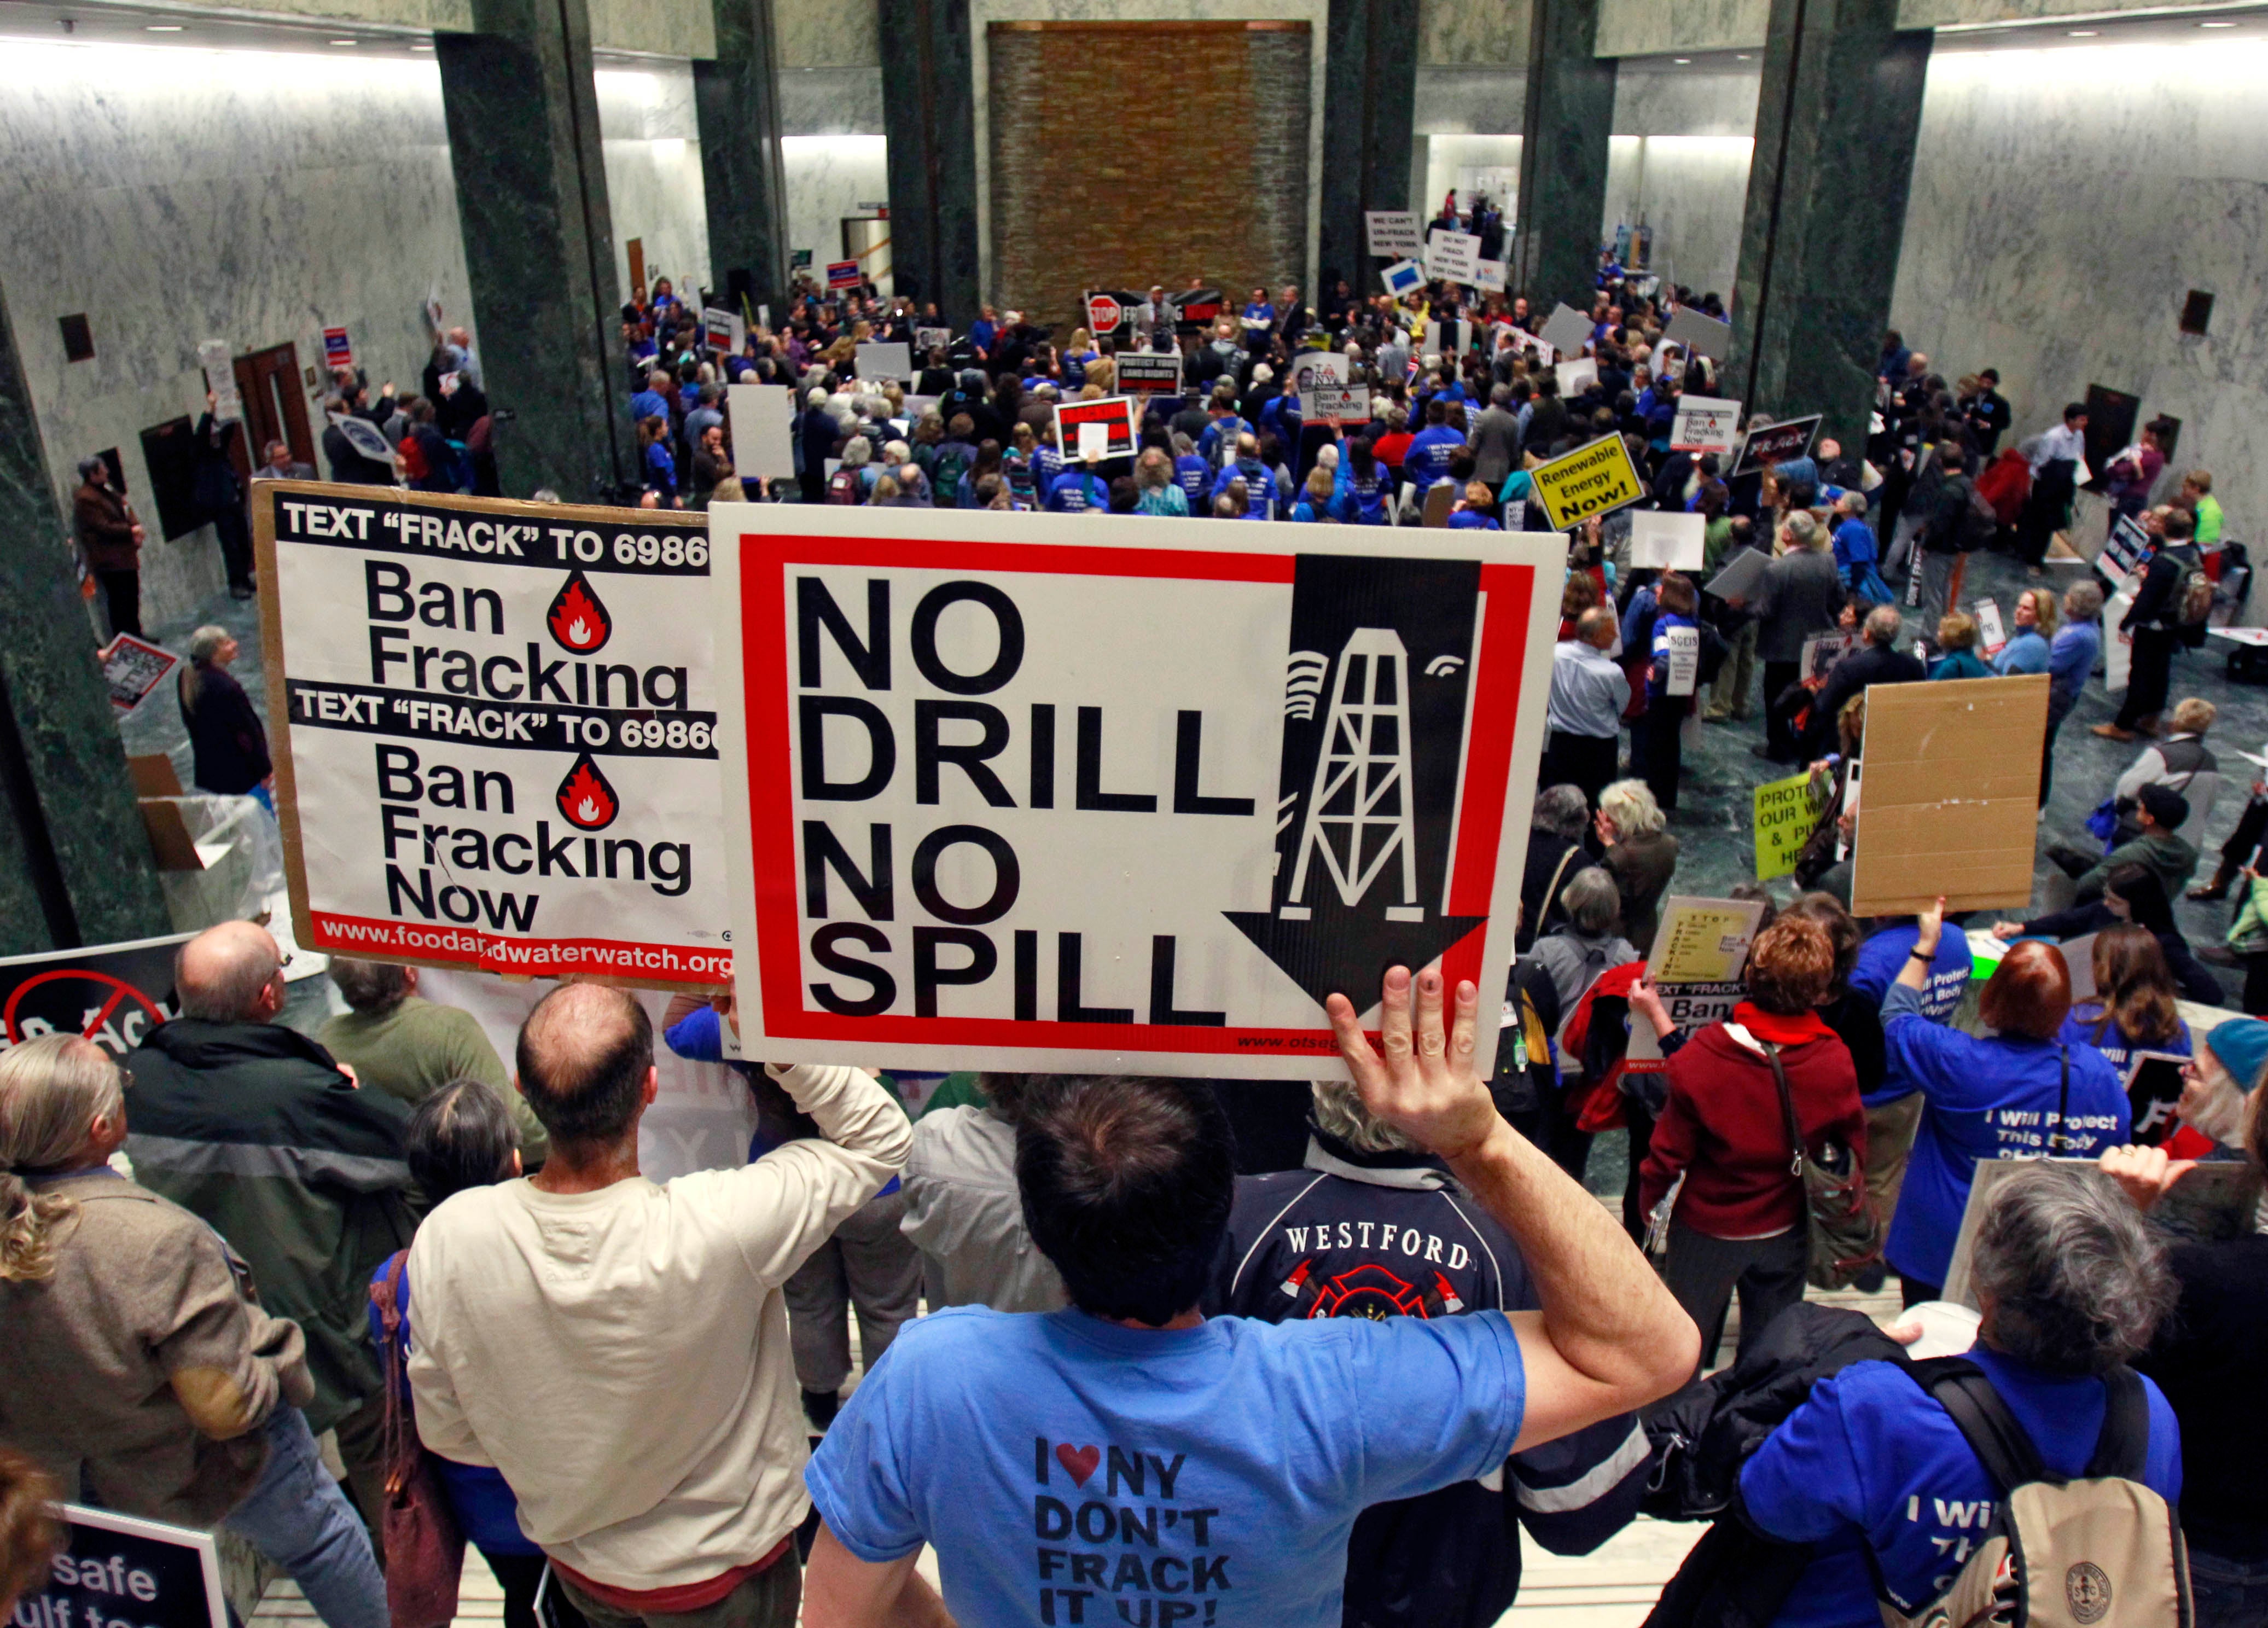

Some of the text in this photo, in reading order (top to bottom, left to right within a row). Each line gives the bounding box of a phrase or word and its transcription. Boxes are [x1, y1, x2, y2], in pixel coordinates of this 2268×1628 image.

[1314, 392, 1336, 401] Ban
[1315, 401, 1363, 411] Fracking
[1685, 427, 1724, 439] Fracking
[1541, 446, 1619, 487] Renewable
[1561, 470, 1611, 499] Energy
[1560, 481, 1629, 521] Now!
[283, 502, 375, 540] TEXT
[383, 511, 539, 556] “FRACK”
[549, 528, 603, 562] TO
[364, 559, 505, 635] Ban
[796, 577, 1025, 695] NO
[294, 688, 385, 723] TEXT
[393, 699, 547, 741] “FRACK”
[558, 716, 610, 746] TO
[800, 695, 1255, 817] DRILL
[375, 742, 515, 815] Ban
[1760, 806, 1796, 828] OUR
[380, 803, 691, 897] Fracking
[1771, 832, 1782, 847] &
[802, 821, 1021, 927] NO
[384, 863, 540, 932] Now
[809, 922, 1226, 1028] SPILL
[1655, 982, 1683, 994] EXT
[1934, 966, 1969, 987] Protect
[1671, 999, 1729, 1018] Ban
[1985, 1109, 1994, 1124] I
[1999, 1109, 2040, 1127] Will
[1997, 1129, 2042, 1147] This
[1286, 1222, 1469, 1270] WESTFORD
[1034, 1437, 1188, 1499] I NY
[1034, 1495, 1220, 1549] DON'T
[1907, 1494, 1920, 1523] I
[51, 1554, 158, 1602] safe
[1038, 1548, 1233, 1594] FRACK
[1039, 1588, 1218, 1628] IT UP!
